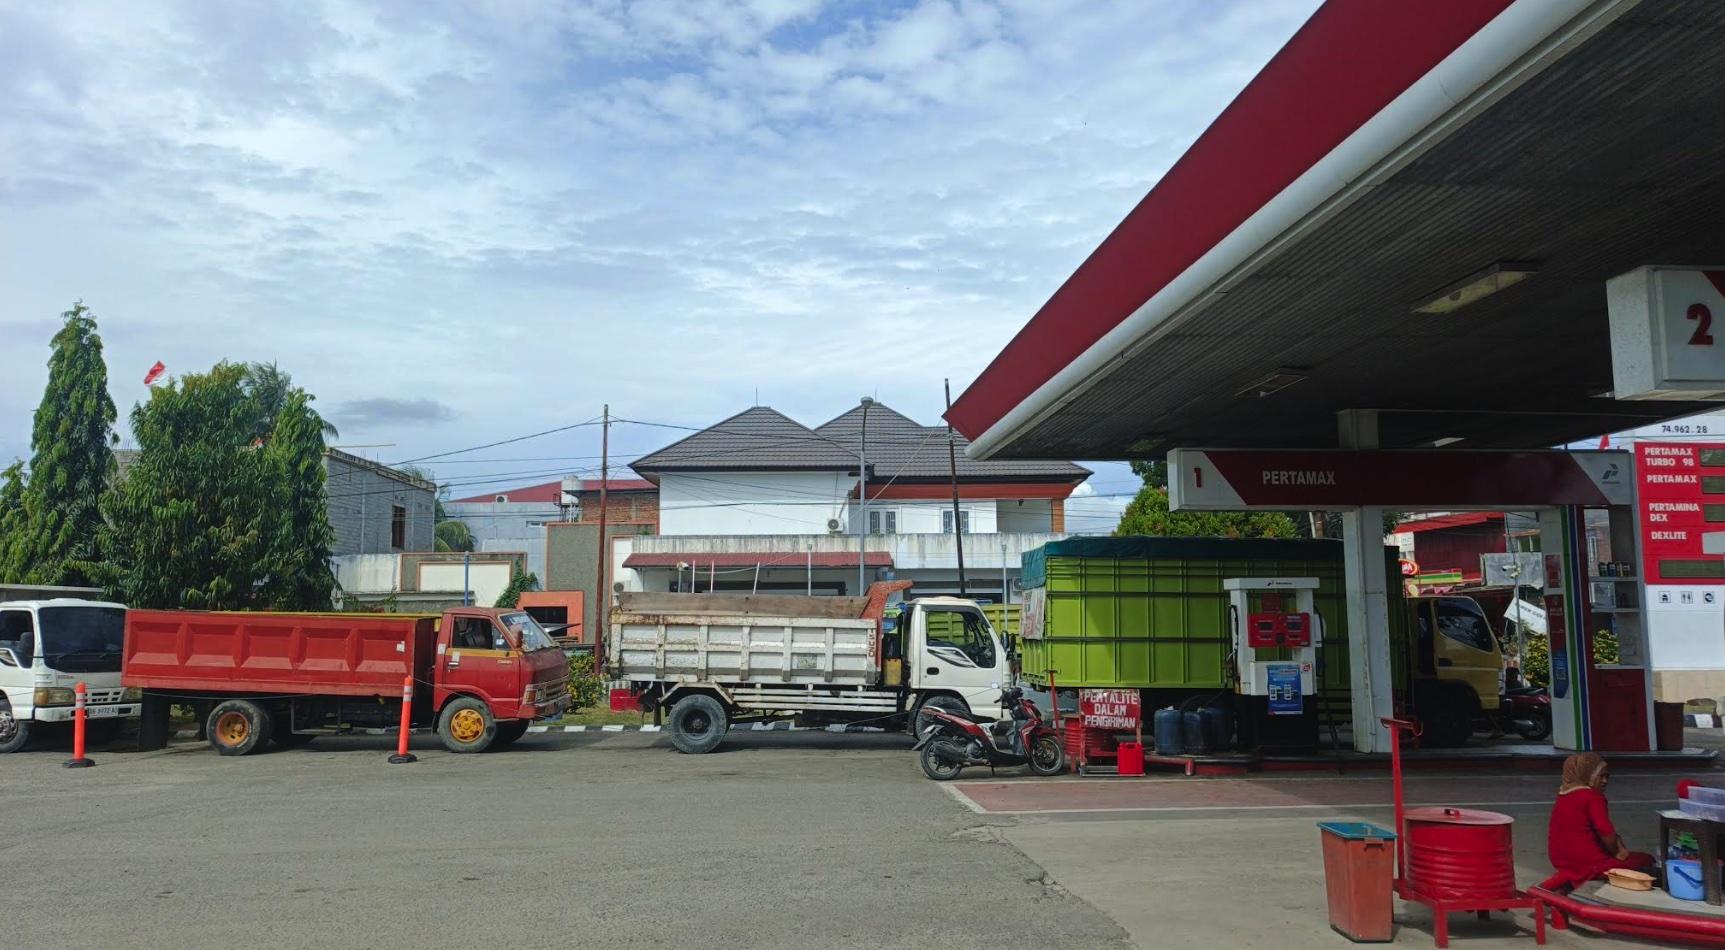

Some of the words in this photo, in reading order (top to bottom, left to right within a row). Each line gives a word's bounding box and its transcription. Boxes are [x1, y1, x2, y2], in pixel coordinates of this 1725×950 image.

[1686, 302, 1714, 345] 2
[1644, 447, 1693, 456] PERTAMAX
[1646, 458, 1676, 467] TURBO
[1682, 458, 1695, 467] 98
[1193, 467, 1202, 488] 1
[1262, 470, 1336, 485] PERTAMAX
[1647, 474, 1698, 483] PERTAMAX
[1648, 502, 1700, 512] PERTAMINA
[1649, 513, 1669, 522] DEX
[1651, 531, 1687, 540] DEXLITE
[1084, 689, 1138, 704] PERTALITE
[1094, 703, 1127, 716] DALAM
[1084, 715, 1136, 728] PENGIRIMAN
